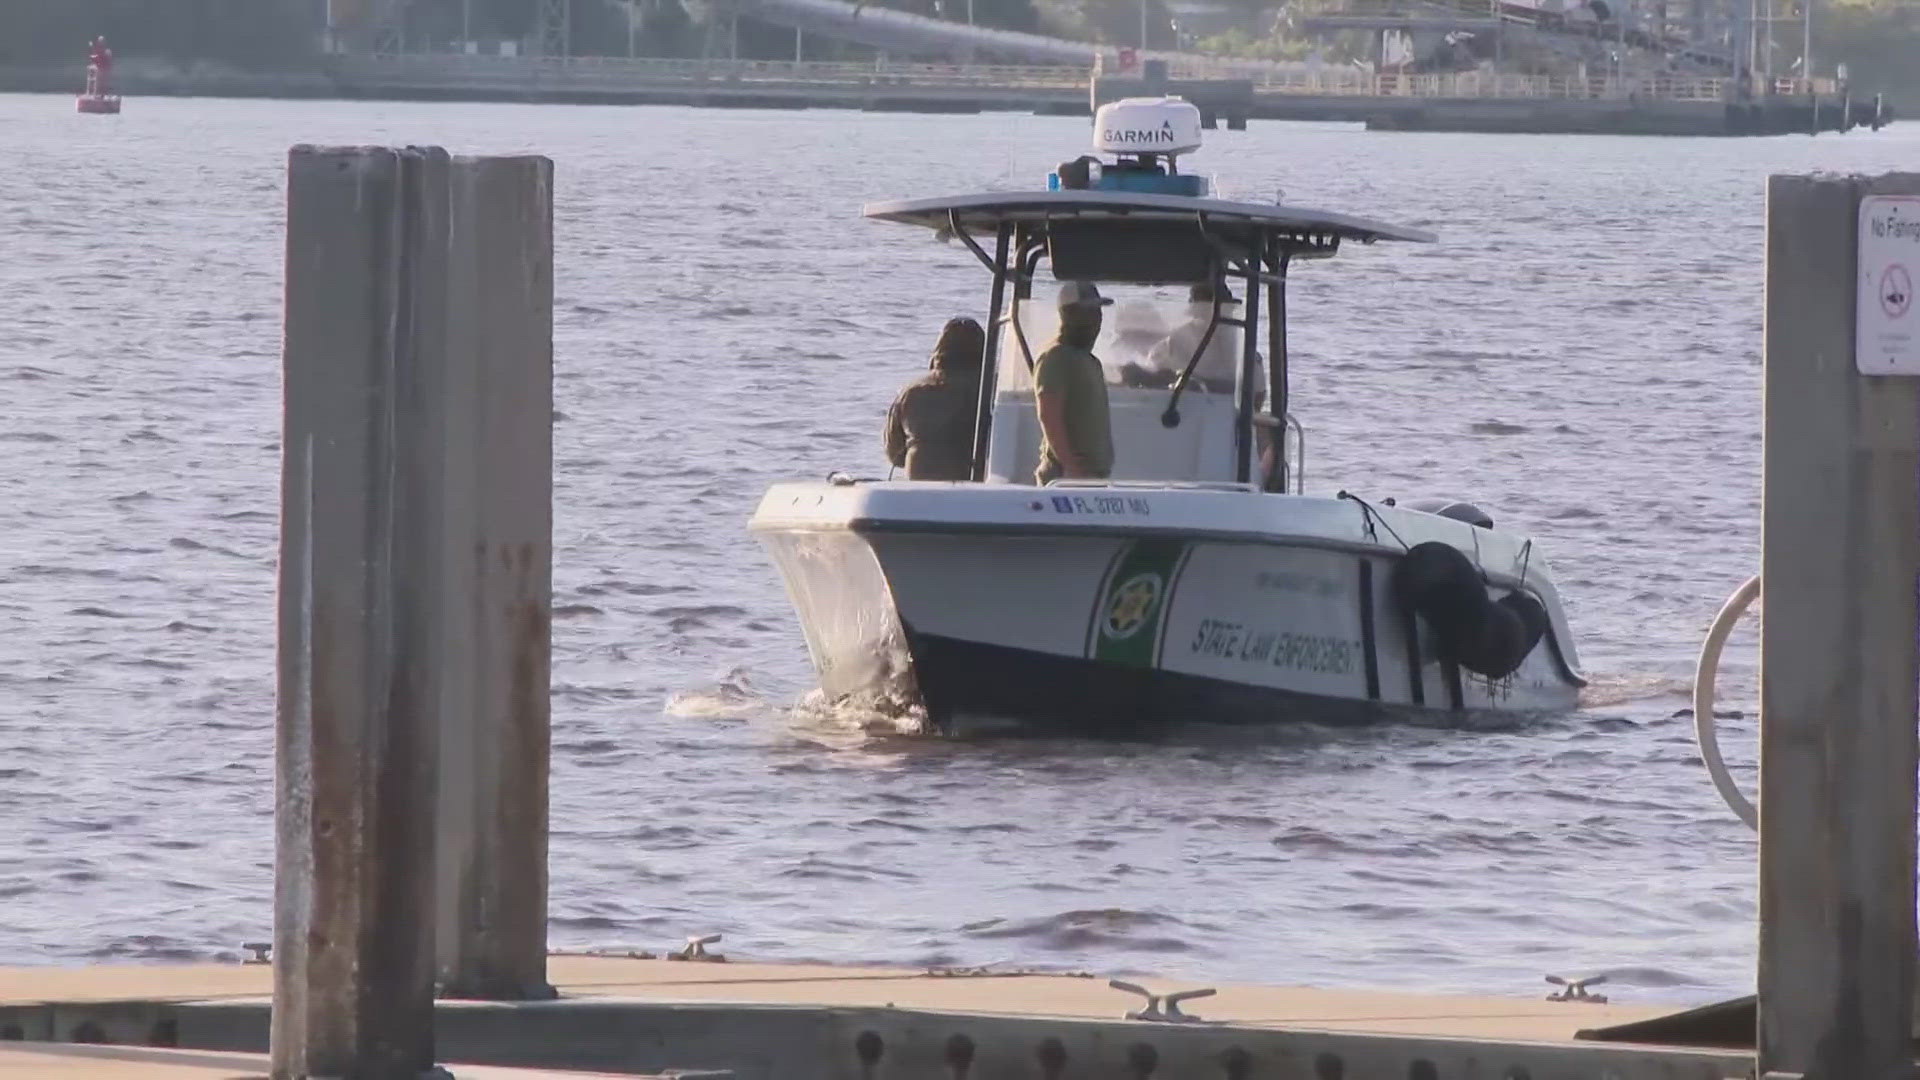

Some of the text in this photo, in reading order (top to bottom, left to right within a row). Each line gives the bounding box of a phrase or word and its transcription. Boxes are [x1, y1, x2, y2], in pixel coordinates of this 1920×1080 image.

[1103, 128, 1174, 143] GARMIN
[1872, 217, 1885, 237] No
[1073, 496, 1093, 514] FL
[1192, 619, 1360, 674] STATE LAW ENFORCEMENT
